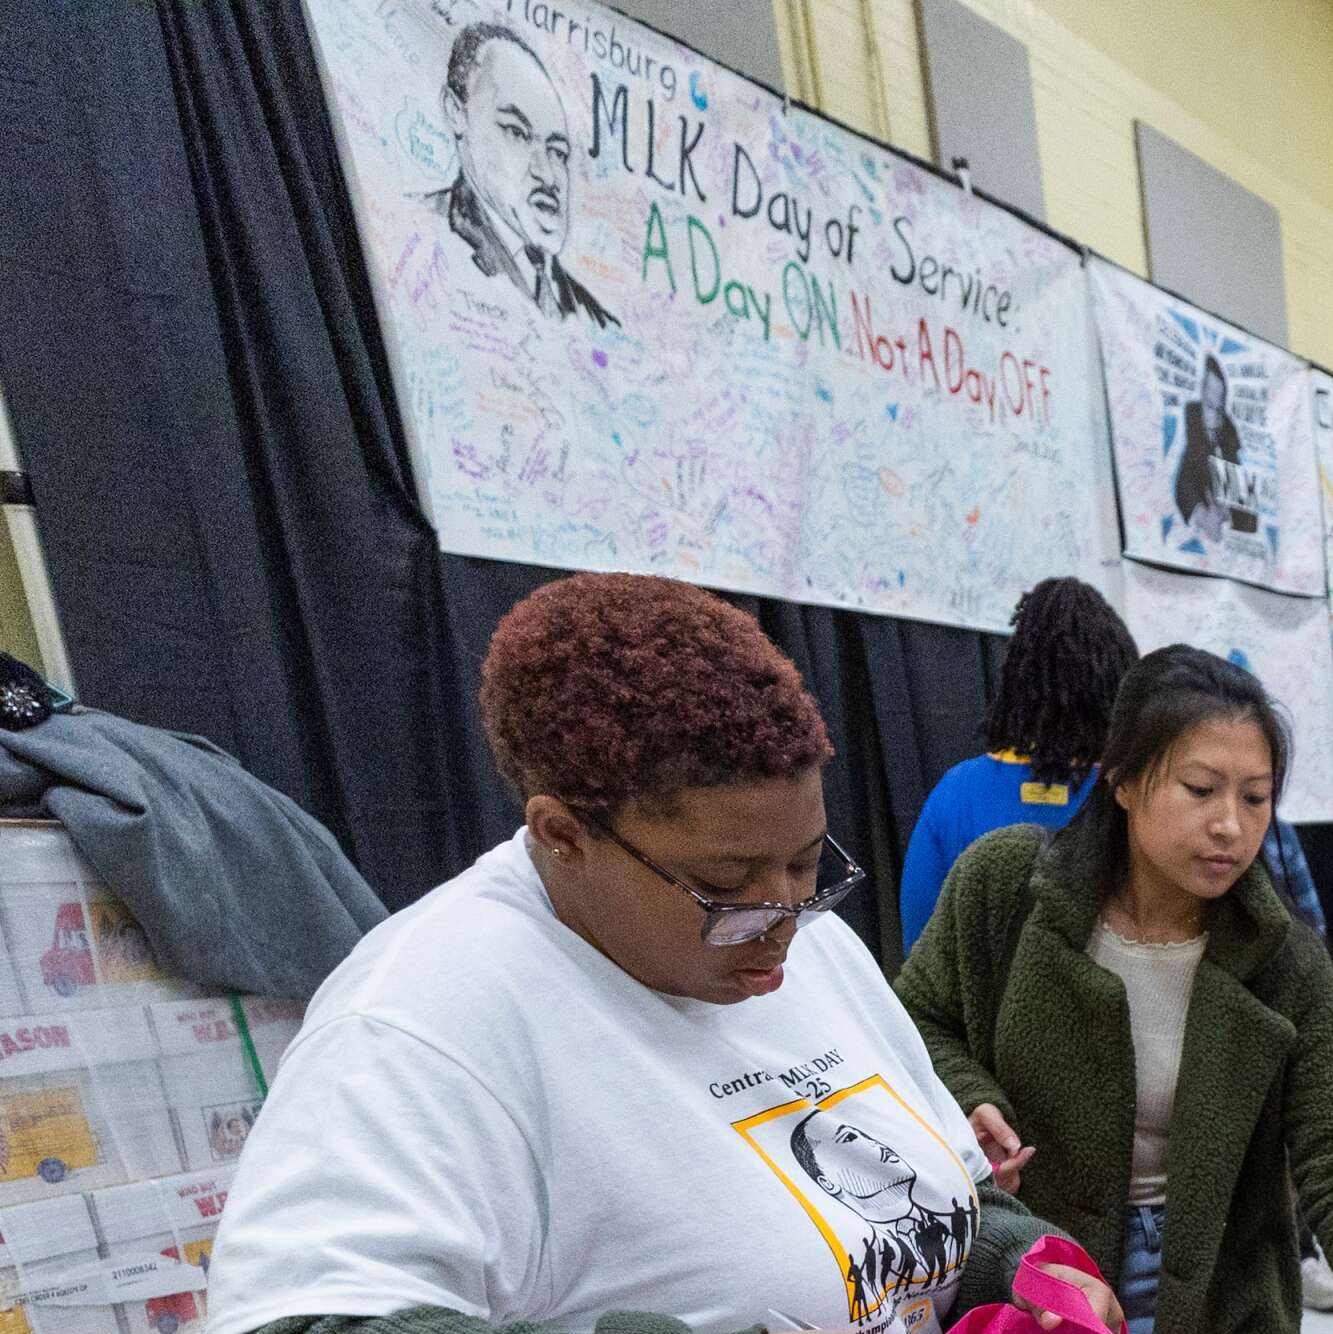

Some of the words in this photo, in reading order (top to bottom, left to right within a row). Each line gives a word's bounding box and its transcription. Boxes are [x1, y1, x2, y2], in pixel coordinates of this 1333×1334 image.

[588, 71, 707, 203] MLK
[732, 142, 812, 264] Day
[824, 204, 862, 264] of
[642, 200, 678, 294] A
[687, 214, 771, 342] Day
[781, 261, 842, 352] ON
[849, 290, 909, 377] Not
[918, 318, 940, 394] A
[943, 325, 997, 424] Day
[999, 350, 1053, 424] OFF
[0, 1024, 71, 1059] ASON
[709, 1069, 775, 1100] Centra
[778, 1063, 819, 1089] MLK
[811, 1048, 845, 1073] DAY
